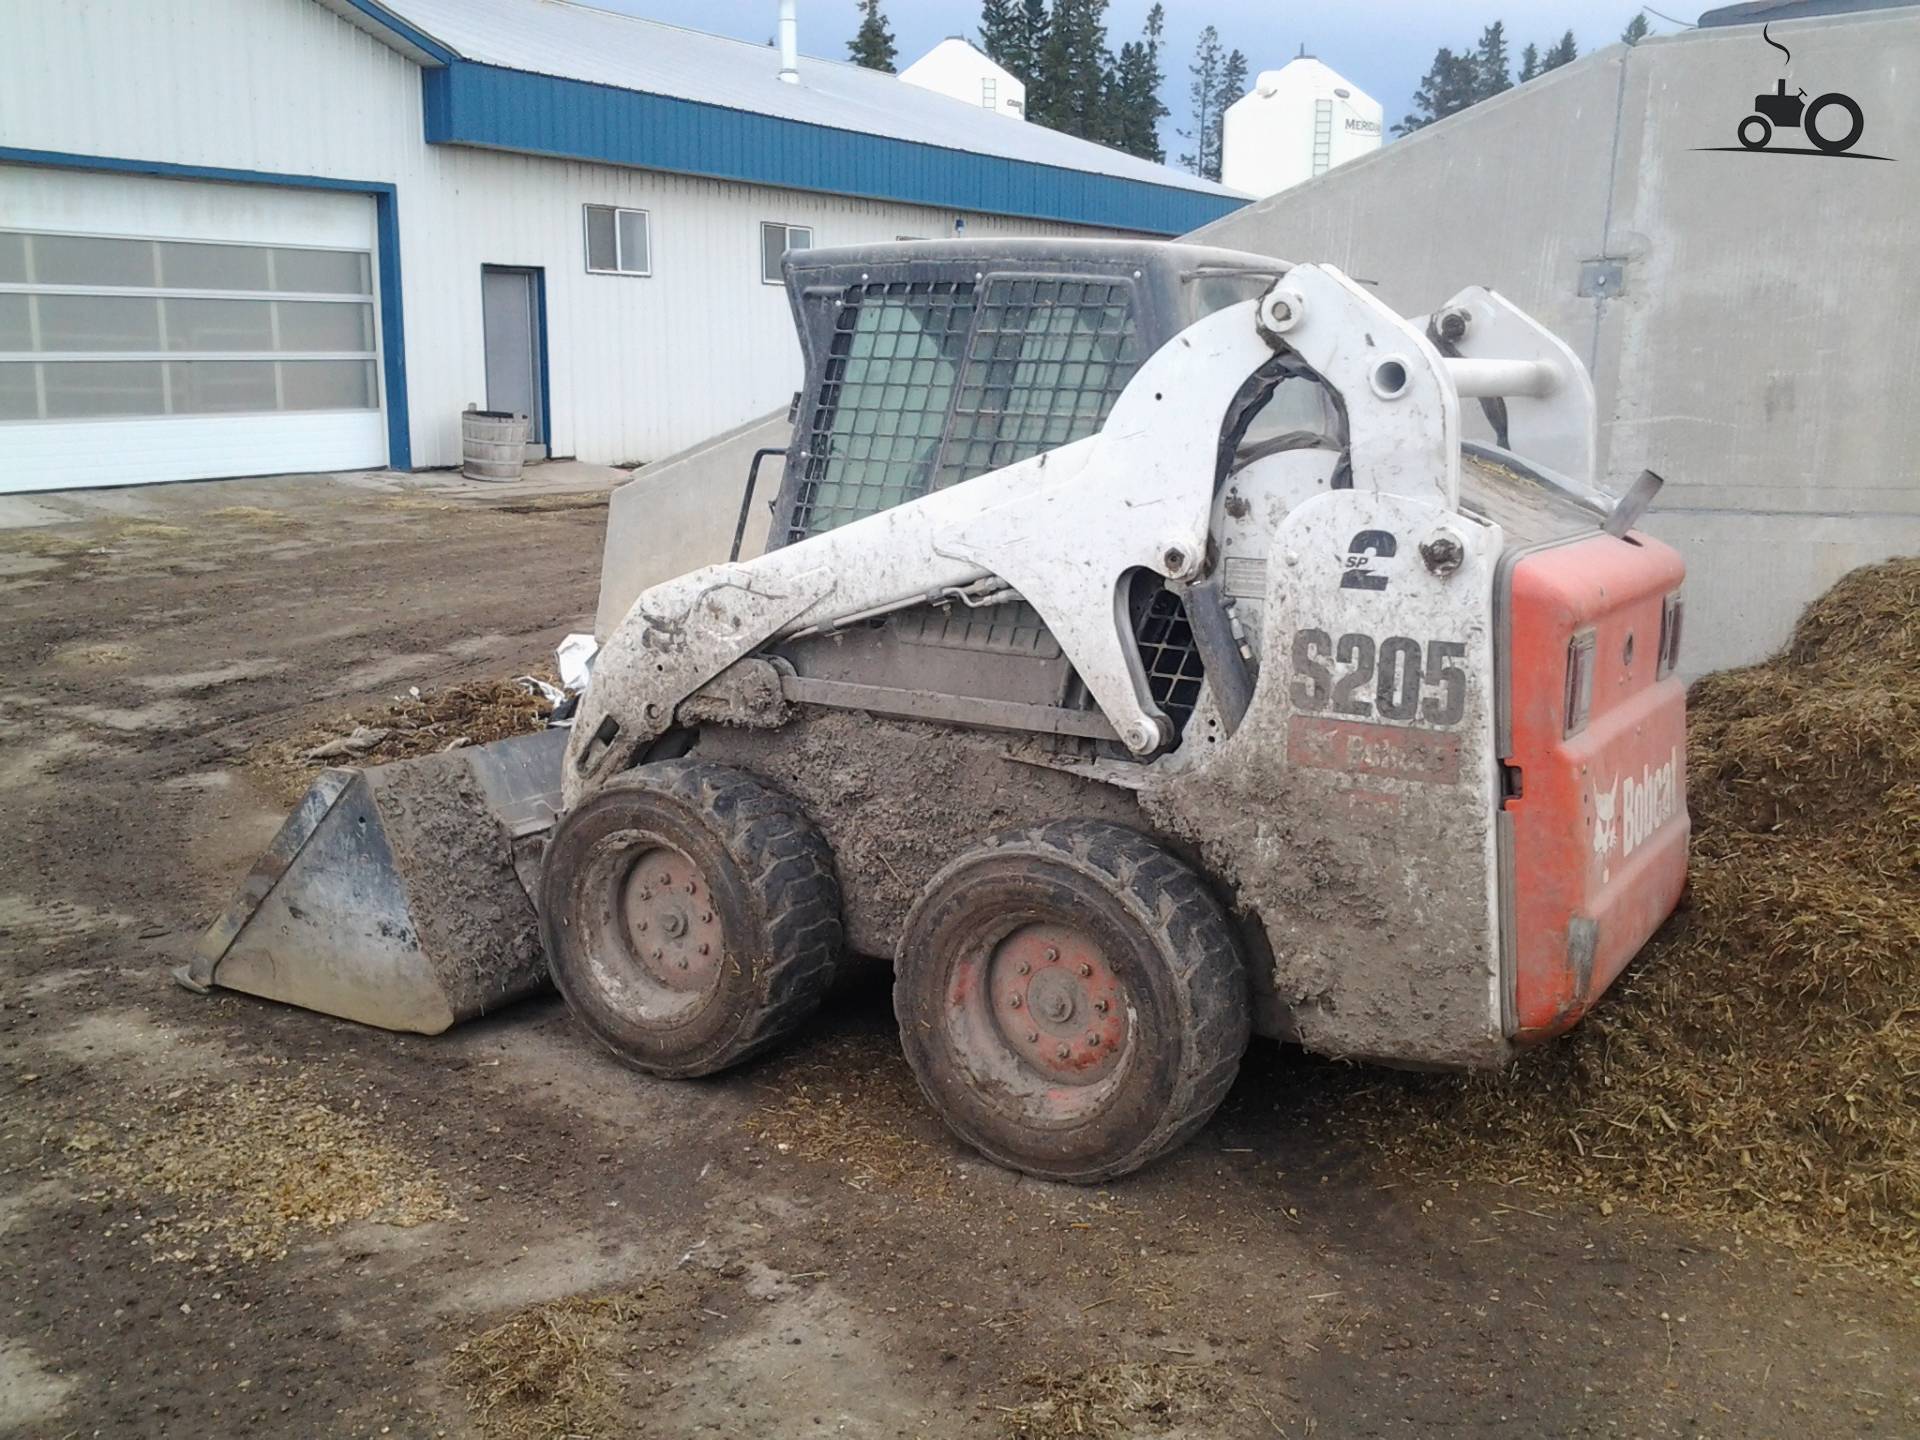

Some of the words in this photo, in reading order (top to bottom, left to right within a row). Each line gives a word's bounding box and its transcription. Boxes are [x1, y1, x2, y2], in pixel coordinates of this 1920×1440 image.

[1339, 529, 1397, 592] 2
[1345, 556, 1369, 568] SP
[1288, 628, 1467, 726] S205
[1623, 745, 1677, 857] Bobcat
